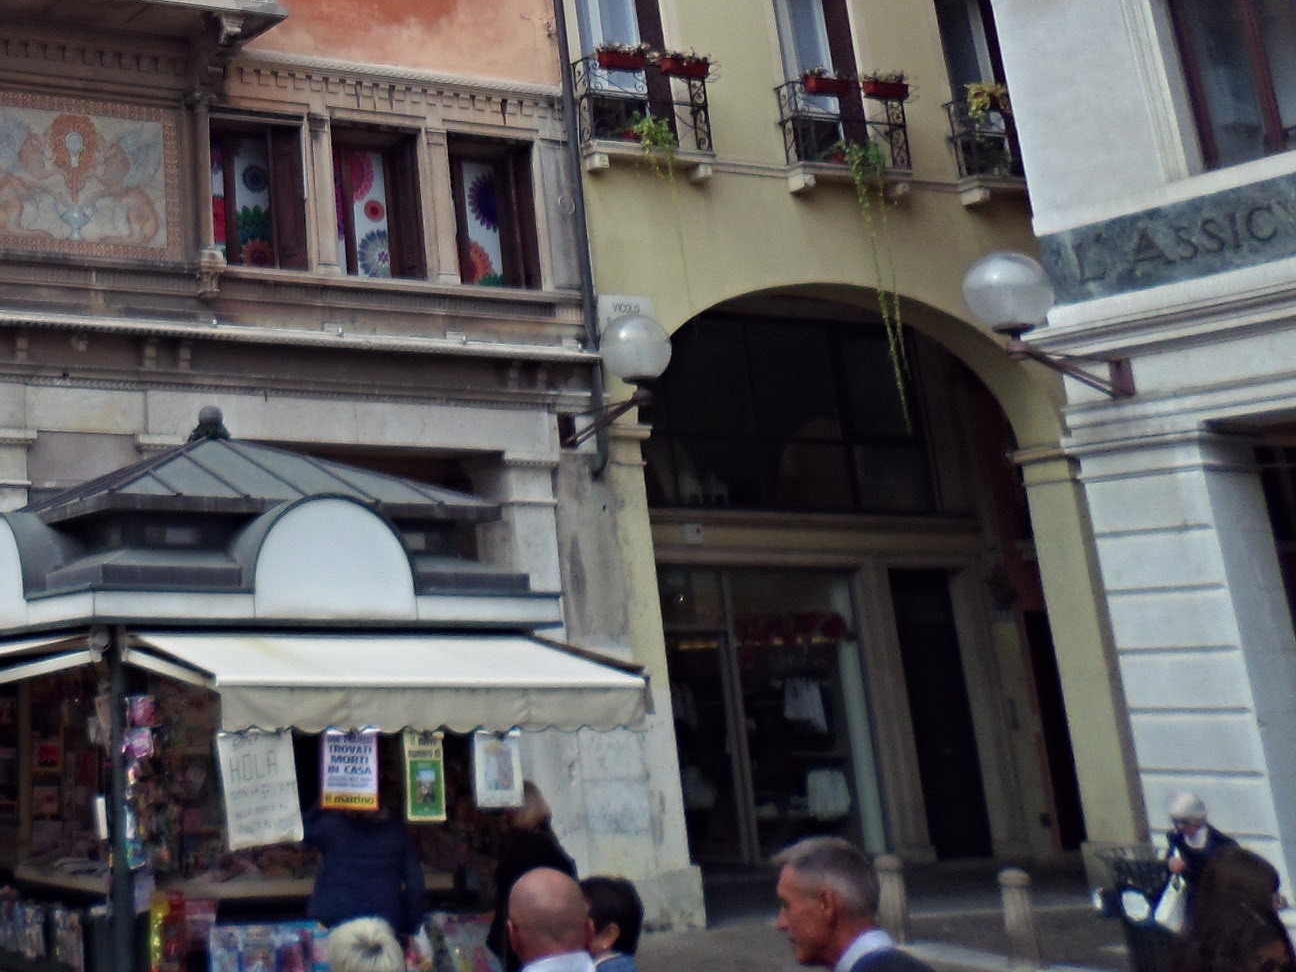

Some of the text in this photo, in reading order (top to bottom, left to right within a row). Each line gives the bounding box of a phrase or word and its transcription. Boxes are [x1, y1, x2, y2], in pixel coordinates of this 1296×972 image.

[612, 302, 640, 314] VICOLO
[329, 745, 372, 754] TROVATI
[330, 755, 369, 764] MORTI
[327, 766, 372, 774] IN CASA
[334, 794, 374, 805] mattino
